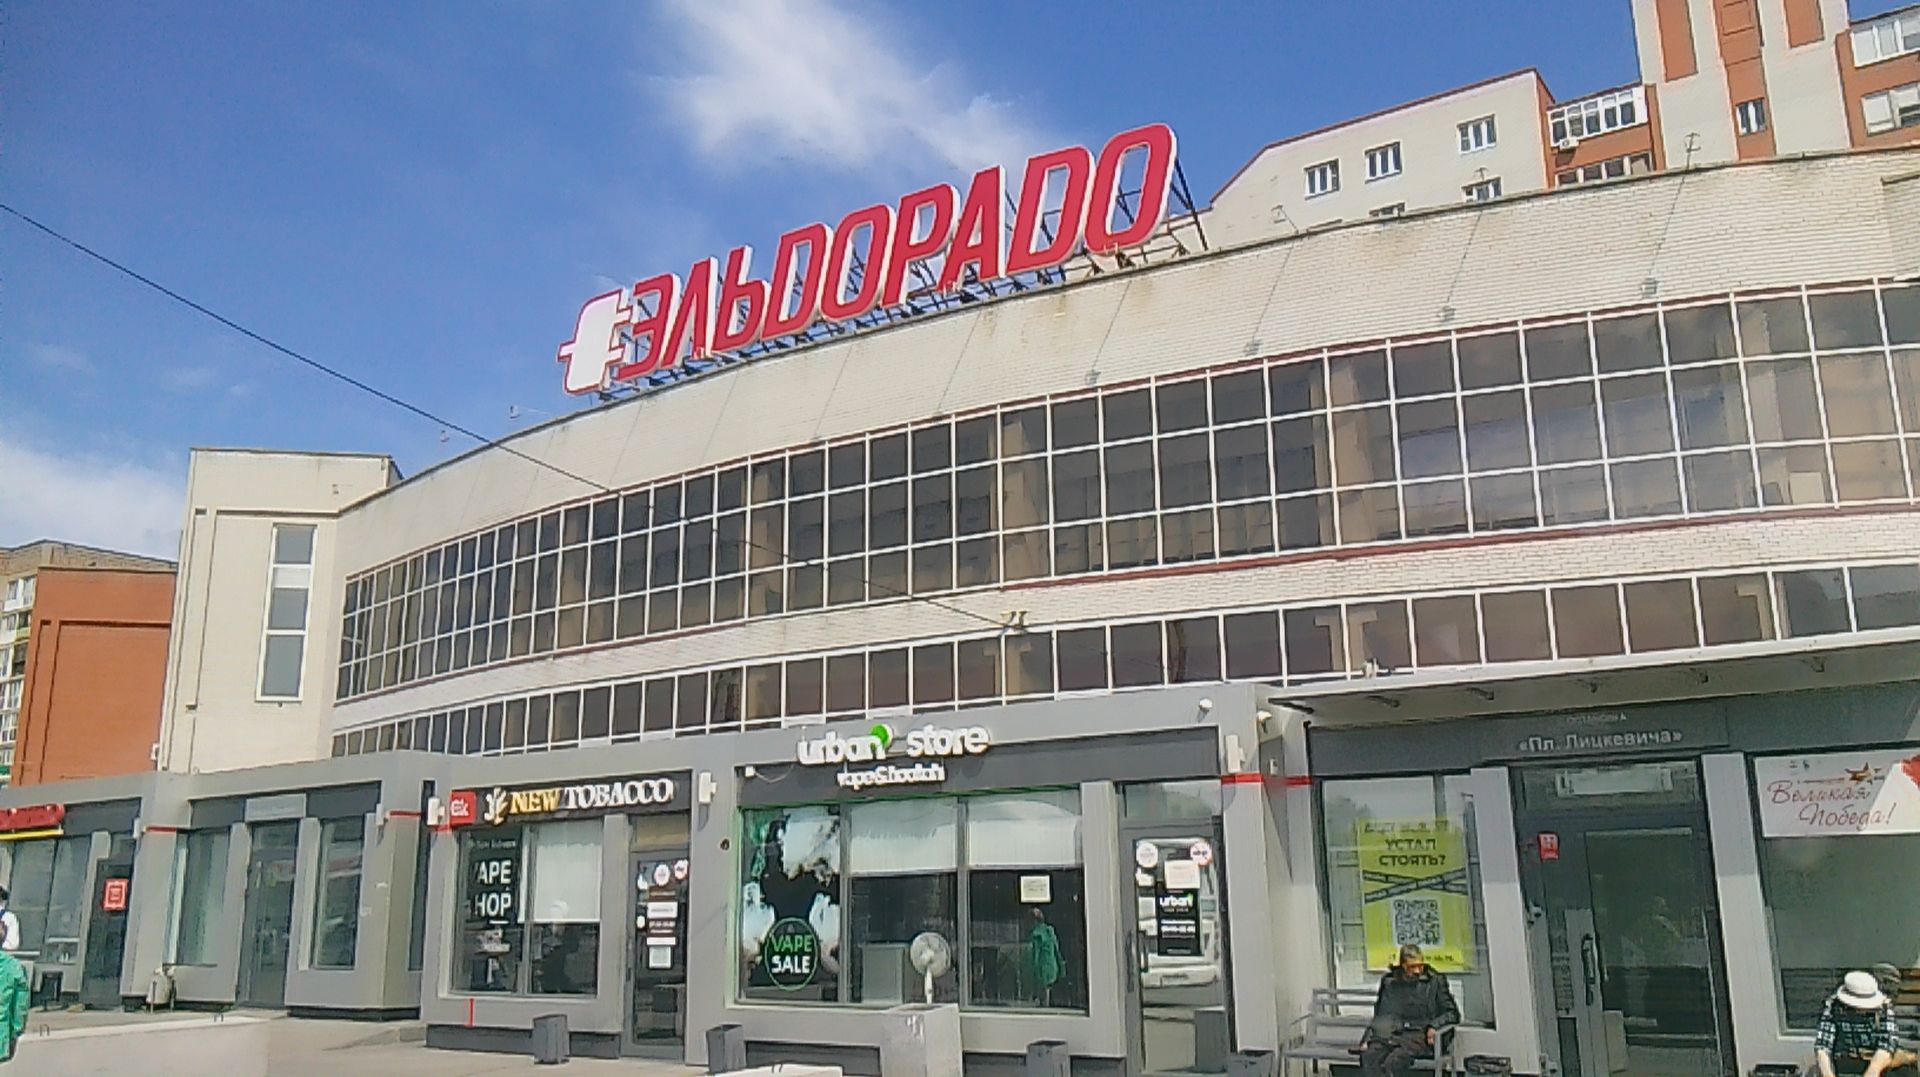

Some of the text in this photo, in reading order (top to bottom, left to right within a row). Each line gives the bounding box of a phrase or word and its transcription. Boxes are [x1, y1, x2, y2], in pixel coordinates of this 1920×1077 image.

[798, 725, 988, 765] urban store
[511, 780, 674, 814] NEW TOBACCO
[1767, 780, 1871, 804] Великая
[1799, 802, 1897, 831] Победа!
[1378, 854, 1446, 867] СТОЯТЬ?
[771, 934, 813, 953] VAPE
[771, 954, 811, 974] SALE
